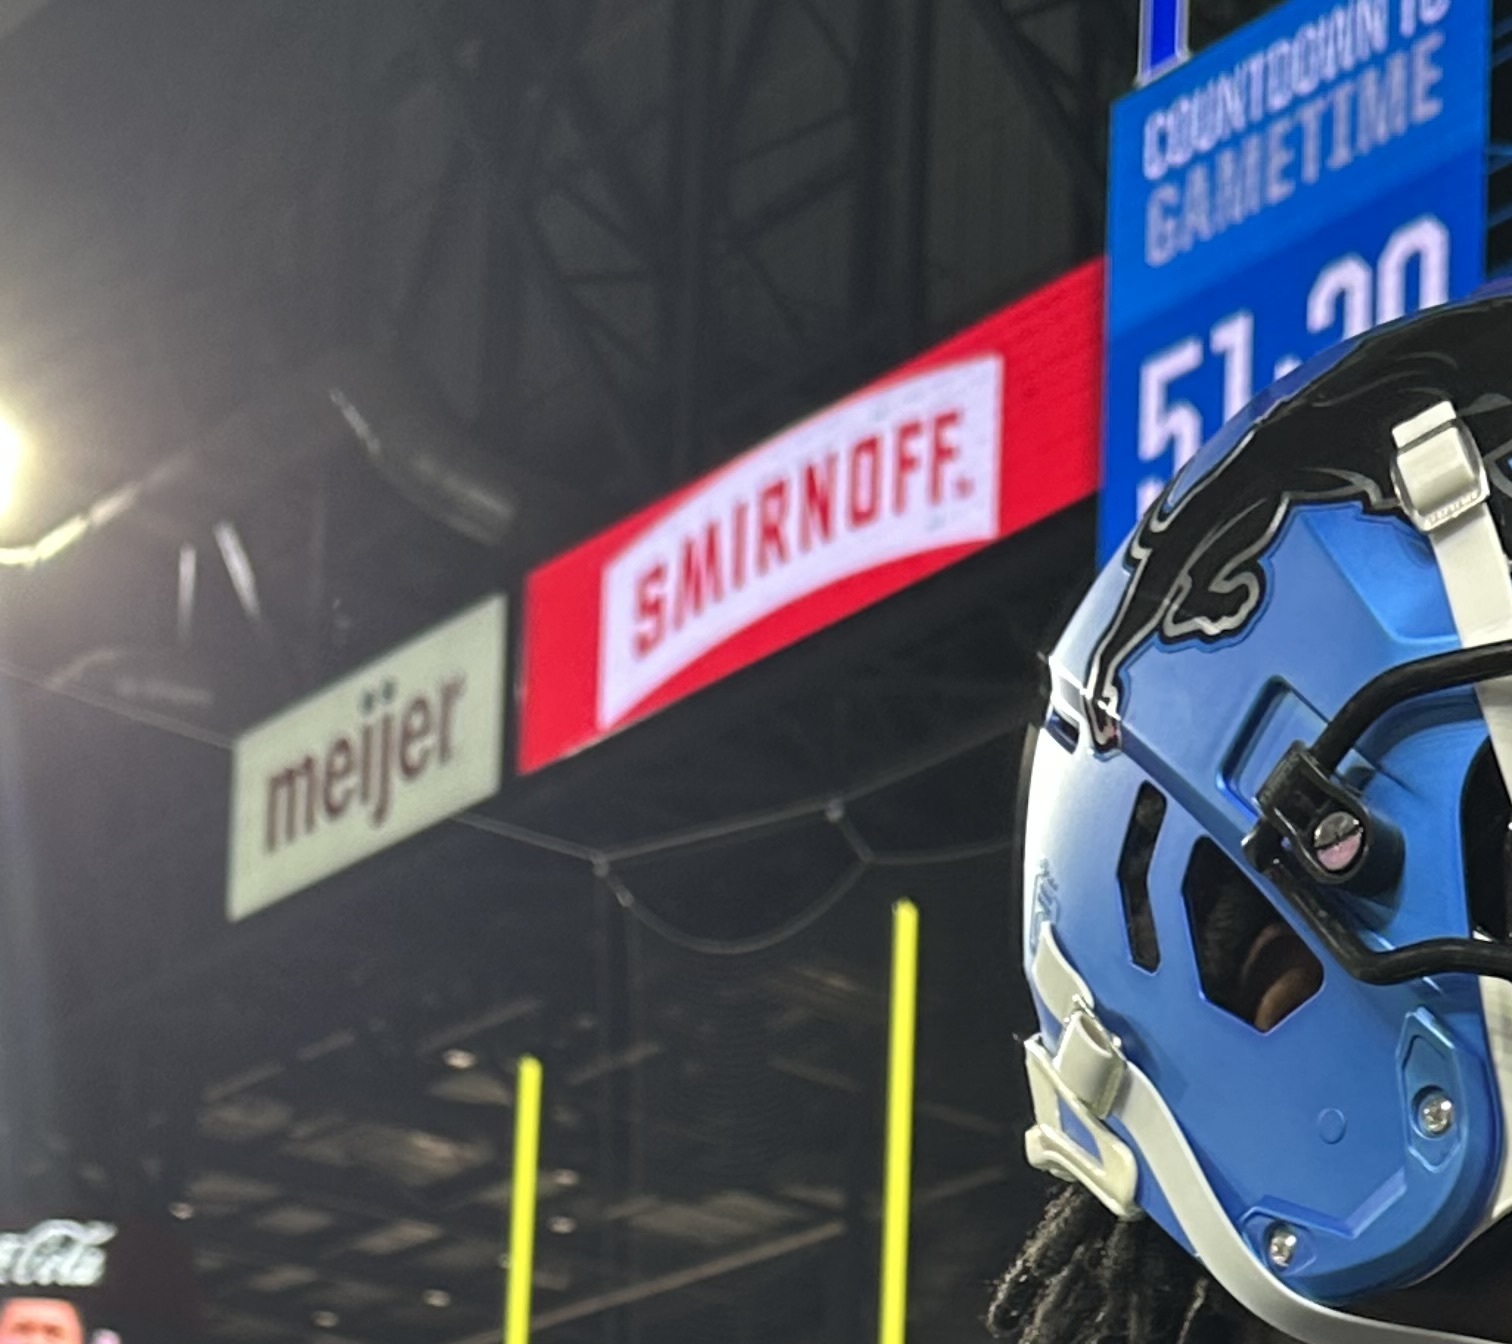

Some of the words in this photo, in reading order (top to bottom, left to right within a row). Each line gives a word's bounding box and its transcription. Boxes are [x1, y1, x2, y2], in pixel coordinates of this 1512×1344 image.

[1142, 0, 1388, 180] COUNTDOWN
[1145, 31, 1444, 266] GAMETIME
[264, 675, 465, 853] meijer
